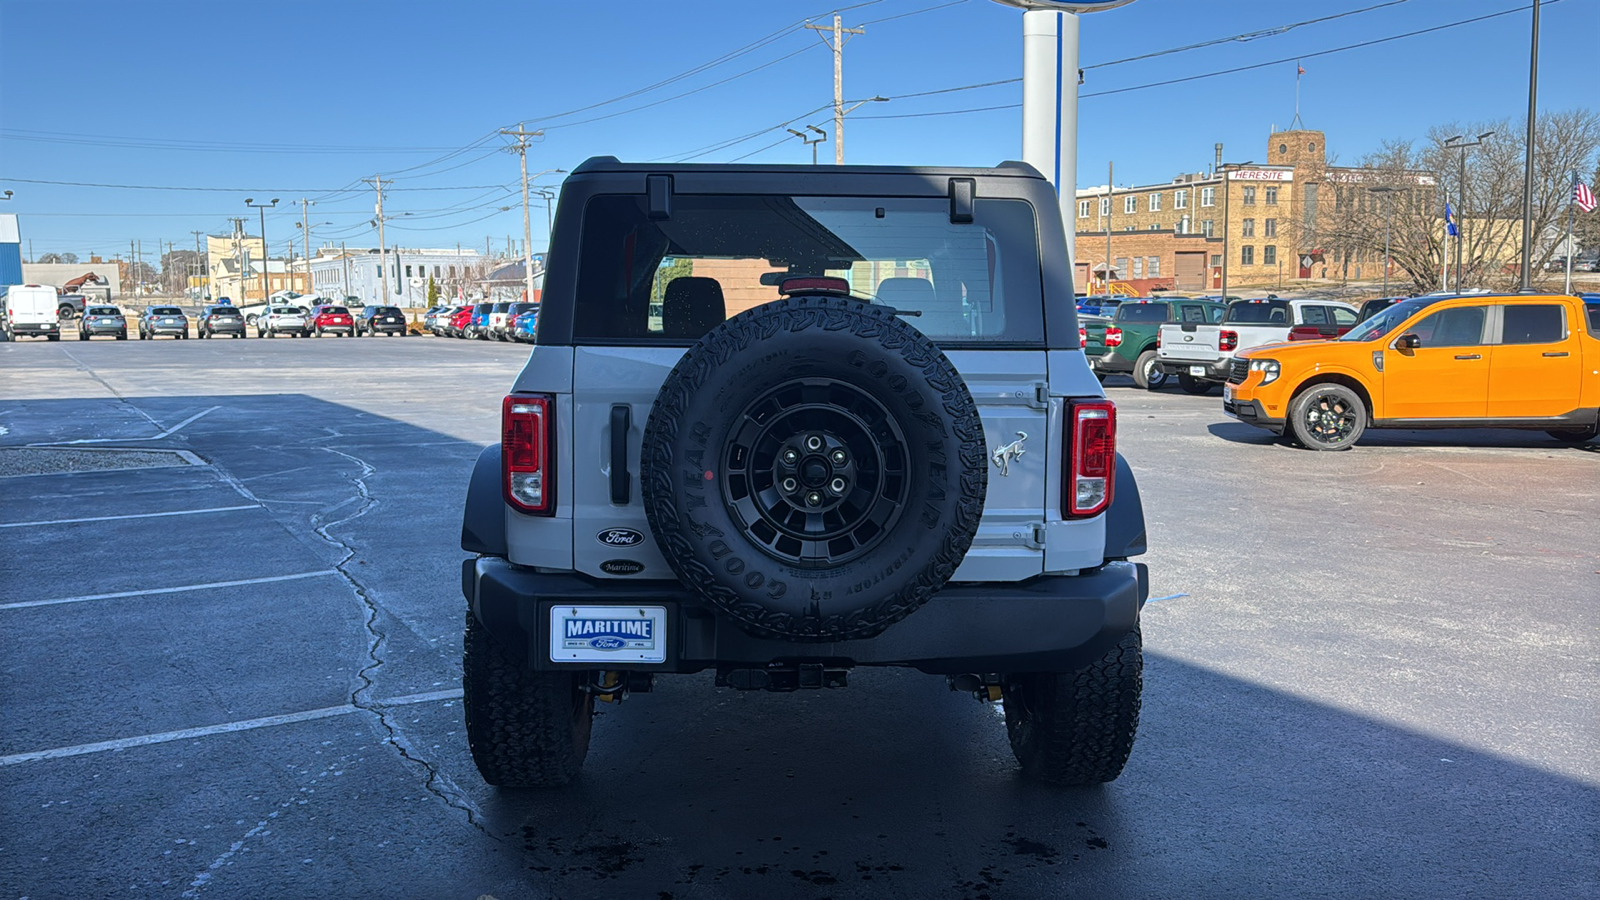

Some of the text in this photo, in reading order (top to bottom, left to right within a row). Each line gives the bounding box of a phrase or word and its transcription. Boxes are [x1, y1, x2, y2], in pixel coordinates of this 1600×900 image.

[1234, 171, 1284, 180] HERESITE
[605, 531, 636, 544] Ford
[605, 563, 640, 572] Maritime
[846, 547, 915, 596] TERRITORY
[567, 620, 651, 638] MARITIME
[595, 638, 620, 648] Ford
